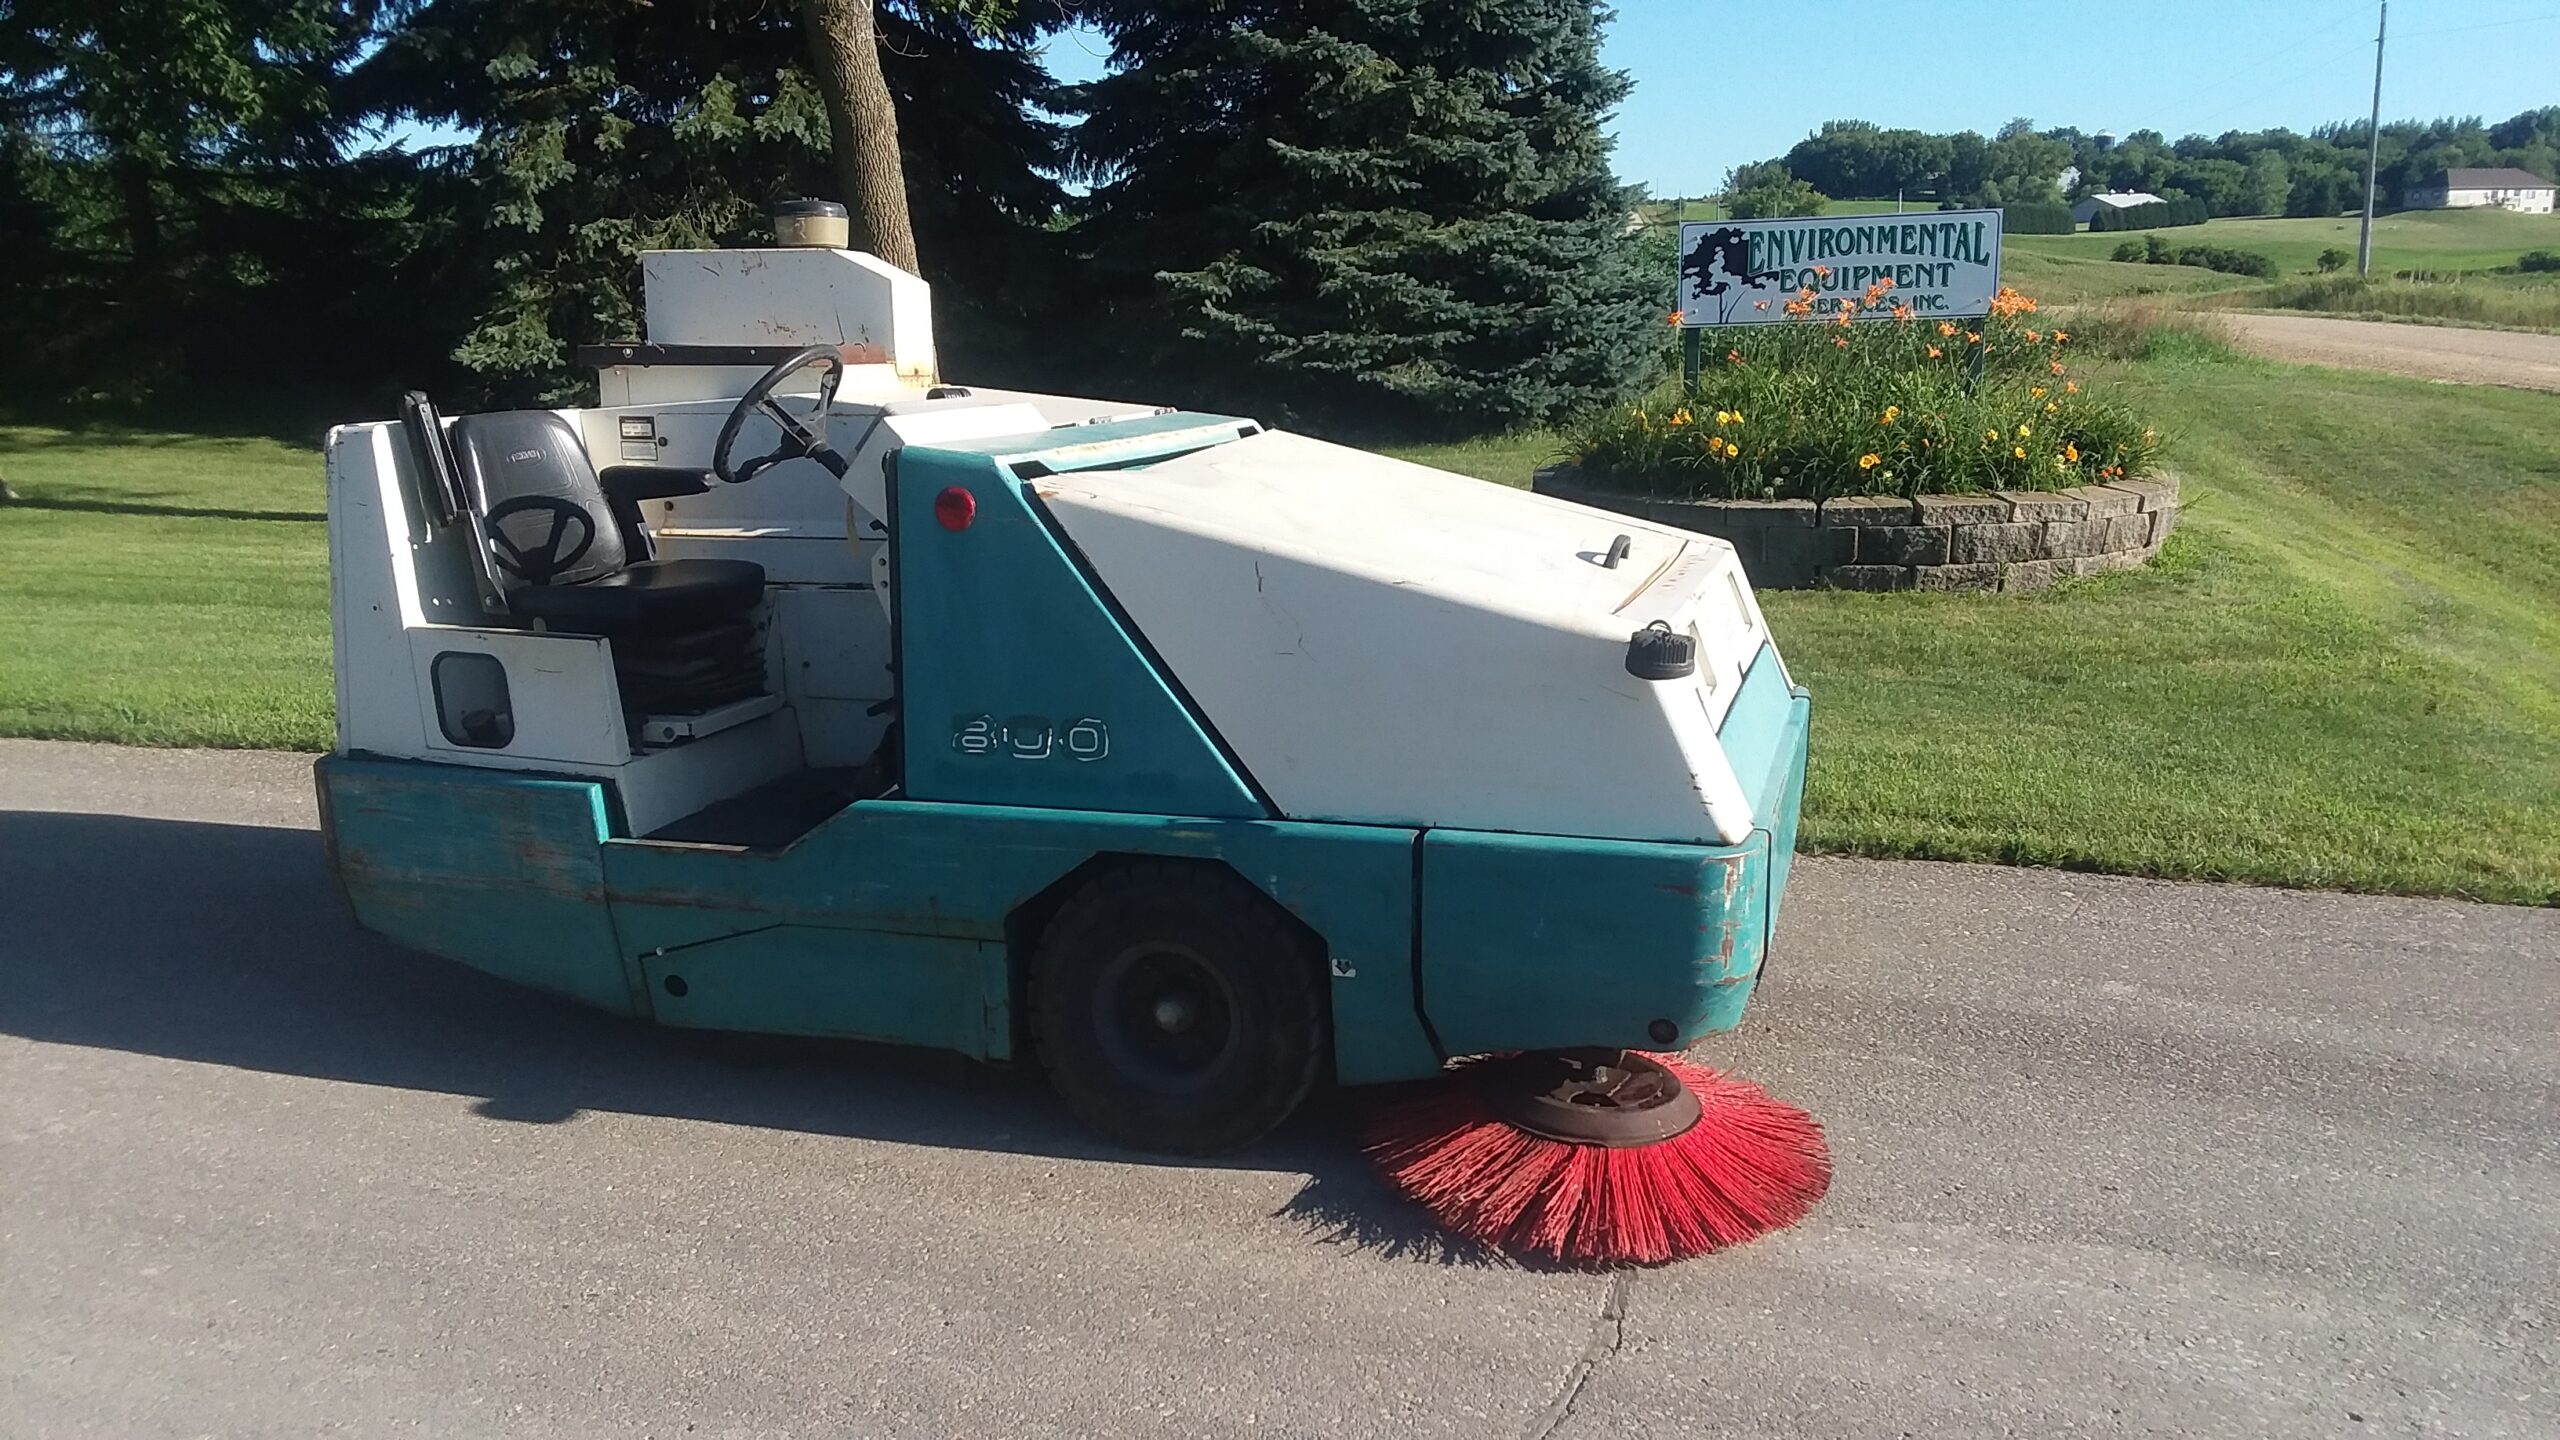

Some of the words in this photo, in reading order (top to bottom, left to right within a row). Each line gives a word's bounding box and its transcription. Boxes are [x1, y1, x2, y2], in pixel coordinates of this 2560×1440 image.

[1749, 221, 1991, 277] ENVIRONMENTAL
[1779, 261, 1956, 293] EQUIPMENT
[1911, 293, 1950, 311] INC.
